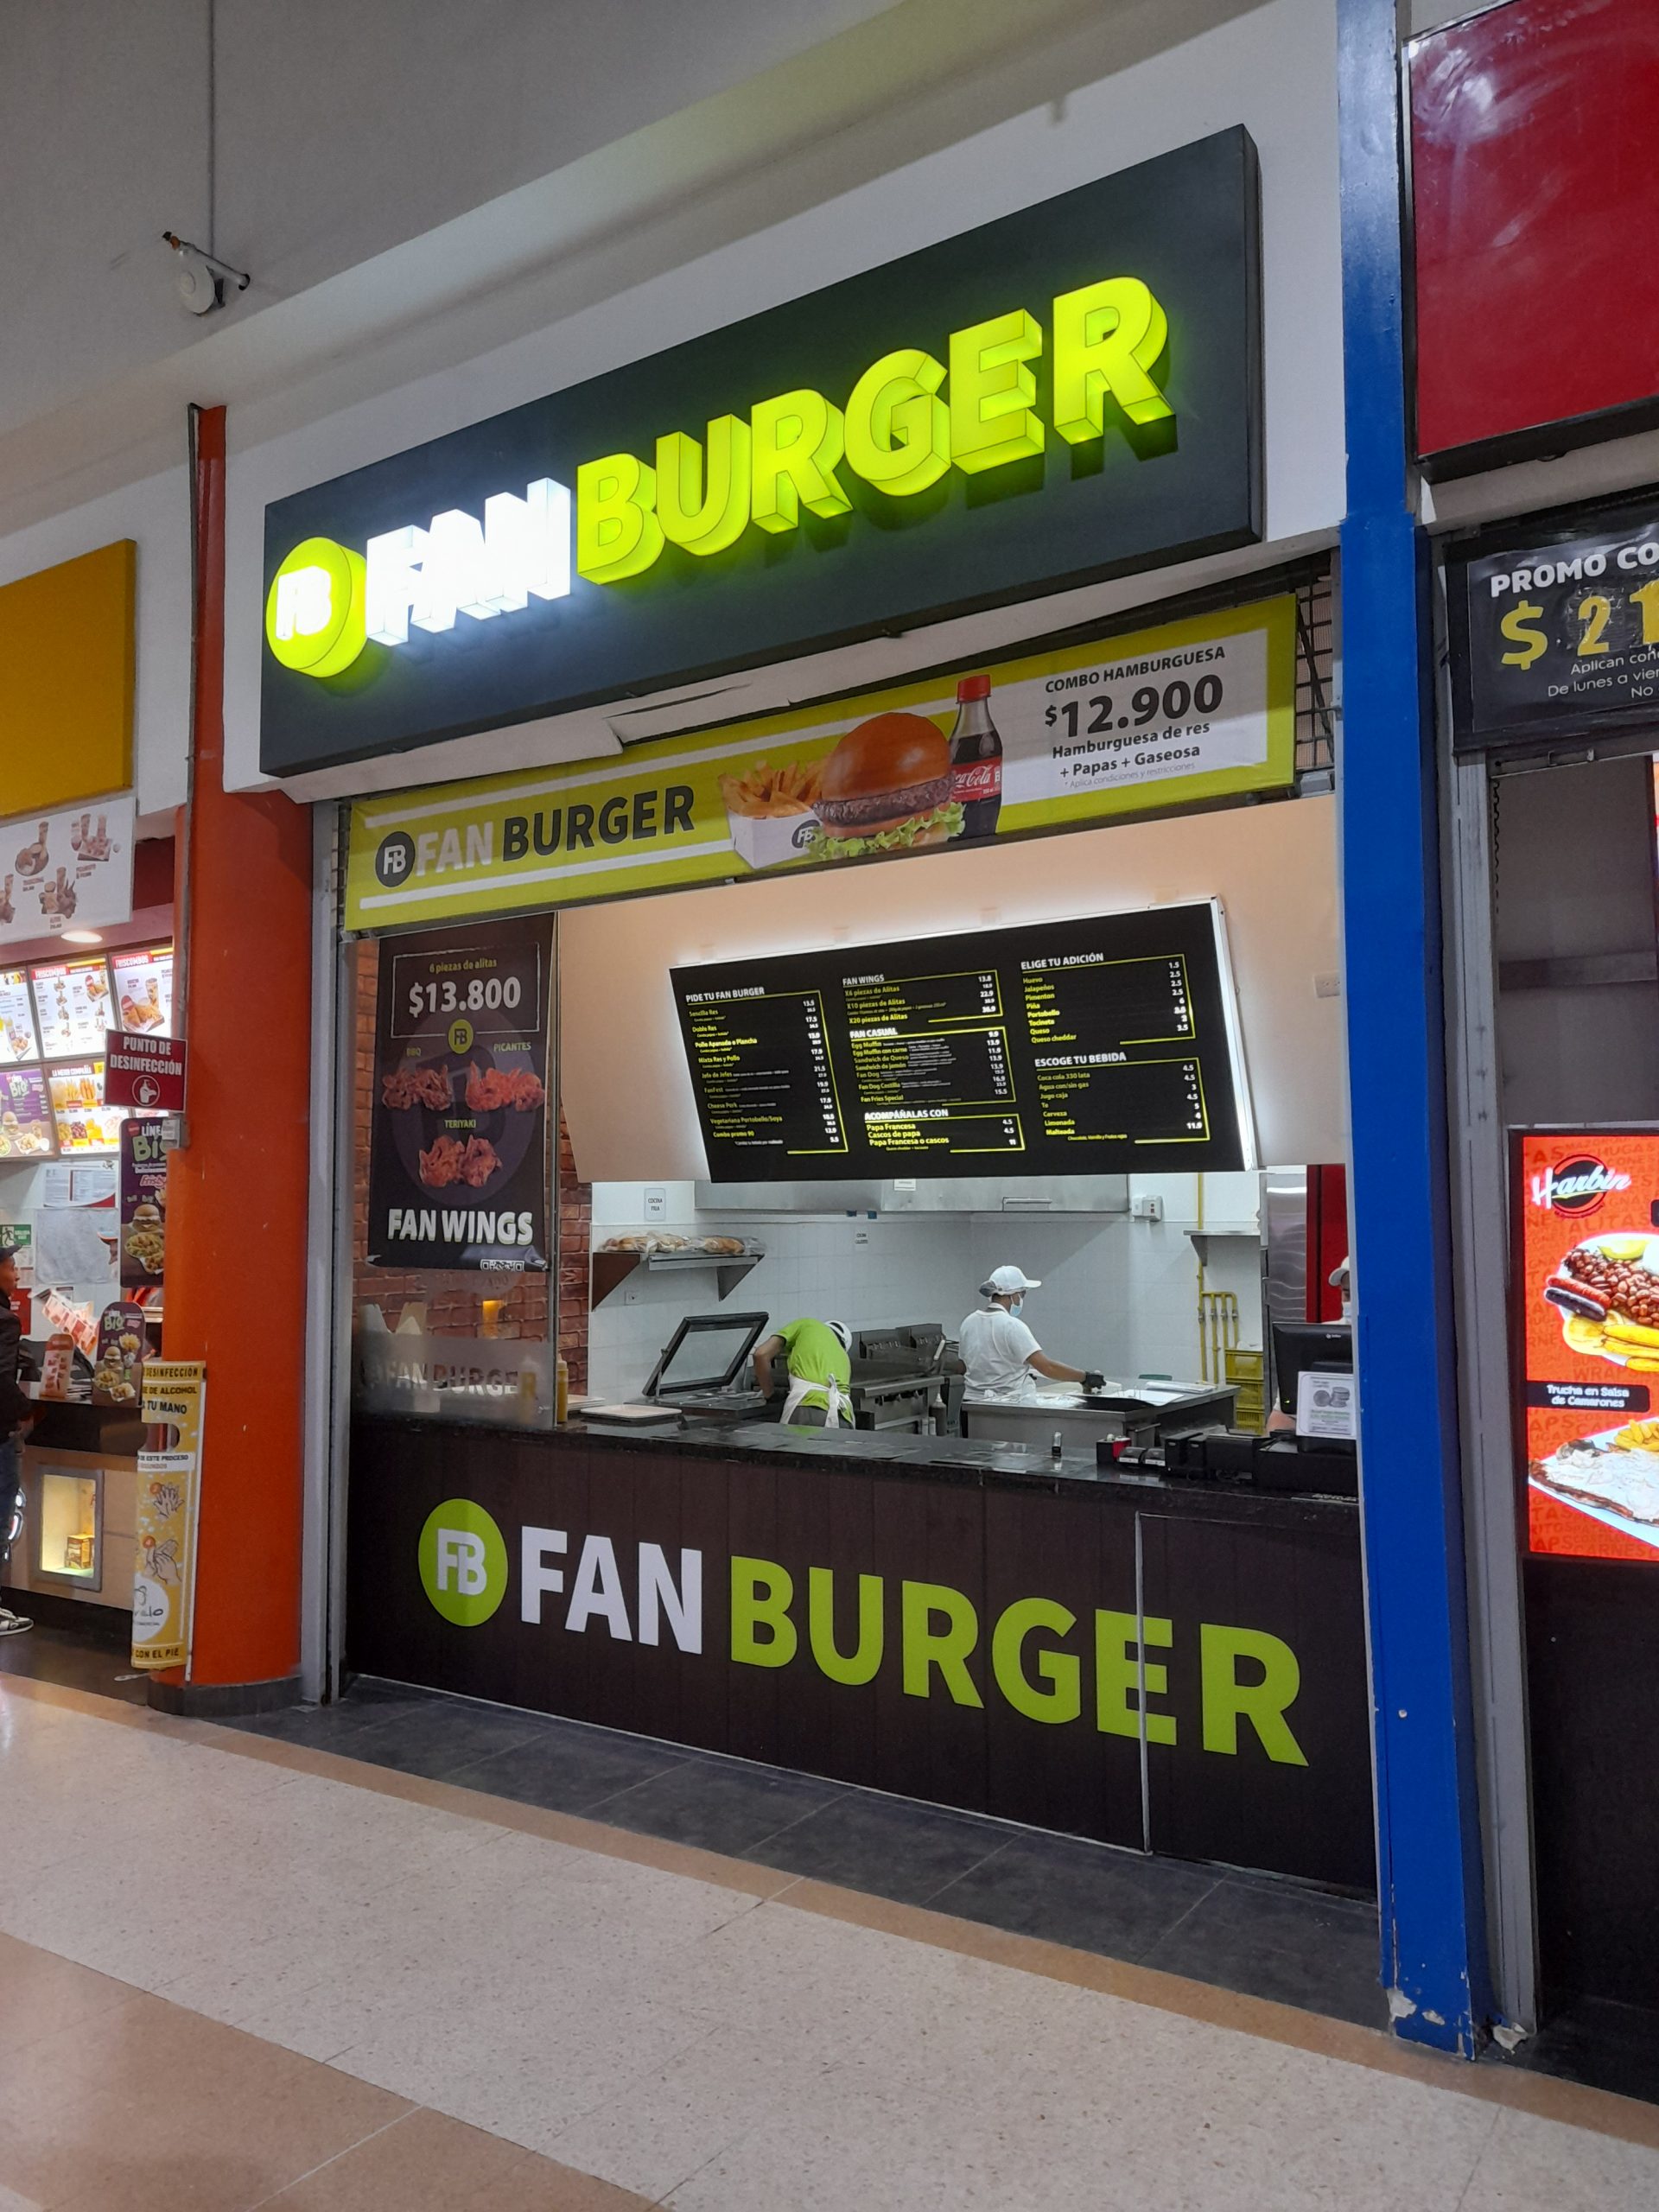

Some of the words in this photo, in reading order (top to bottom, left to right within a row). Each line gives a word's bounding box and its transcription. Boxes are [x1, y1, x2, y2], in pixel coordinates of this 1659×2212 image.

[366, 477, 570, 646] FAN
[577, 276, 1173, 585] BURGER
[1491, 554, 1607, 598] PROMO
[1045, 671, 1100, 693] COMBO
[1103, 646, 1225, 683] HAMBURGUESA
[1571, 657, 1624, 675] Aplican
[1630, 650, 1659, 664] con
[1548, 685, 1569, 697] De
[1573, 677, 1613, 692] lunes
[1618, 675, 1628, 684] a
[1631, 686, 1654, 699] No
[1045, 674, 1224, 738] $12.900
[1052, 732, 1159, 759] Hamburguesa
[1162, 726, 1183, 740] de
[1185, 722, 1211, 736] res
[1073, 760, 1117, 777] Papas
[1135, 746, 1200, 766] Gaseosa
[1094, 771, 1140, 785] condiciones
[1147, 762, 1195, 776] restricciones
[416, 821, 493, 876] FAN
[501, 785, 695, 862] BURGER
[429, 964, 435, 973] 6
[435, 962, 461, 974] piezas
[463, 959, 474, 969] de
[474, 957, 497, 969] alitas
[1020, 959, 1047, 969] ELIGE
[1048, 957, 1061, 967] TU
[1063, 952, 1104, 965] ADICIÓN
[842, 977, 857, 986] FAN
[858, 974, 885, 984] WINGS
[1024, 984, 1055, 993] Jalapeños
[409, 976, 521, 1018] $13.800
[685, 994, 703, 1002] PIDE
[715, 991, 731, 1000] FAN
[732, 987, 765, 998] BURGER
[1027, 1009, 1060, 1018] Portobello
[849, 1030, 866, 1039] FAN
[867, 1027, 899, 1037] CASUAL
[124, 1036, 156, 1053] PUNTO
[159, 1041, 171, 1055] DE
[493, 1042, 531, 1052] PICANTES
[110, 1054, 182, 1076] DESINFECCIÓN
[1034, 1056, 1072, 1067] ESCOGE
[1073, 1055, 1087, 1065] TU
[1089, 1052, 1127, 1064] BEBIDA
[929, 1109, 949, 1117] CON
[444, 1119, 476, 1128] TERIYAKI
[1531, 1164, 1631, 1210] Harbin
[388, 1209, 436, 1242] FAN
[441, 1210, 533, 1245] WINGS
[160, 1386, 197, 1395] ALCOHOL
[1547, 1384, 1582, 1395] Trucha
[1600, 1387, 1630, 1398] Salsa
[148, 1401, 156, 1410] TU
[160, 1402, 188, 1414] MANO
[1551, 1396, 1566, 1405] de
[1567, 1396, 1625, 1408] Camarones
[152, 1649, 162, 1658] EL
[437, 1529, 486, 1595] FB
[521, 1525, 702, 1656] FAN
[730, 1555, 1310, 1768] BURGER
